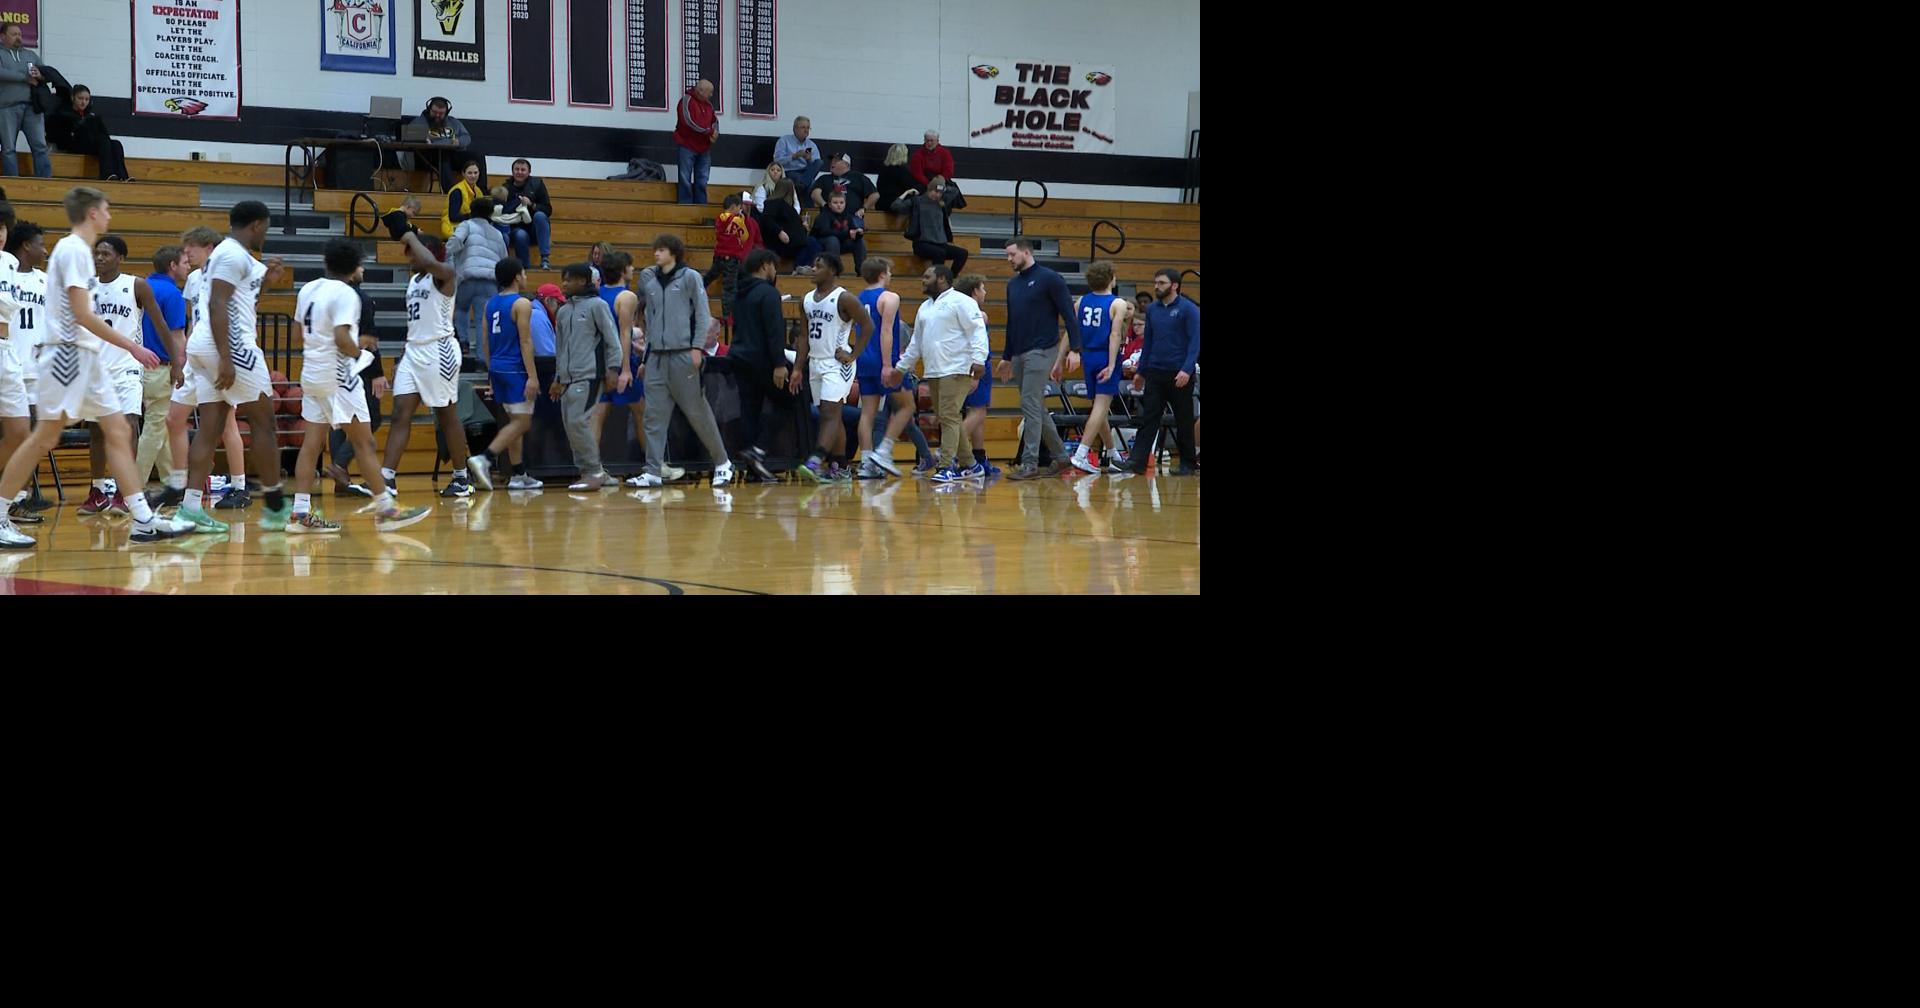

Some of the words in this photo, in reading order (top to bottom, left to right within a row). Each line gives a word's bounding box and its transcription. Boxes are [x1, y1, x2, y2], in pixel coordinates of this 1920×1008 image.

[152, 6, 219, 20] EXPECTATION
[512, 3, 528, 11] 2019
[512, 11, 529, 19] 2020
[177, 19, 207, 27] PLEASE
[351, 13, 366, 34] C
[156, 35, 192, 44] PLAYERS
[193, 38, 217, 46] PLAY.
[341, 38, 379, 50] CALIFORNIA
[154, 52, 190, 61] COACHES
[191, 55, 218, 63] COACH.
[145, 69, 186, 78] OFFICIALS
[187, 72, 227, 81] OFFICIATE.
[630, 68, 646, 76] 2000
[1015, 63, 1071, 86] THE
[171, 79, 186, 87] LET
[630, 76, 645, 84] 2001
[757, 76, 772, 85] 2022
[137, 86, 186, 96] SPECTATORS
[198, 90, 237, 99] POSITIVE.
[630, 91, 645, 99] 2011
[994, 85, 1092, 110] BLACK
[1004, 109, 1082, 132] HOLE
[408, 302, 421, 321] 32
[1082, 306, 1103, 327] 33
[20, 307, 34, 330] 11
[304, 302, 315, 334] 4
[492, 310, 502, 334] 2
[810, 322, 823, 340] 25
